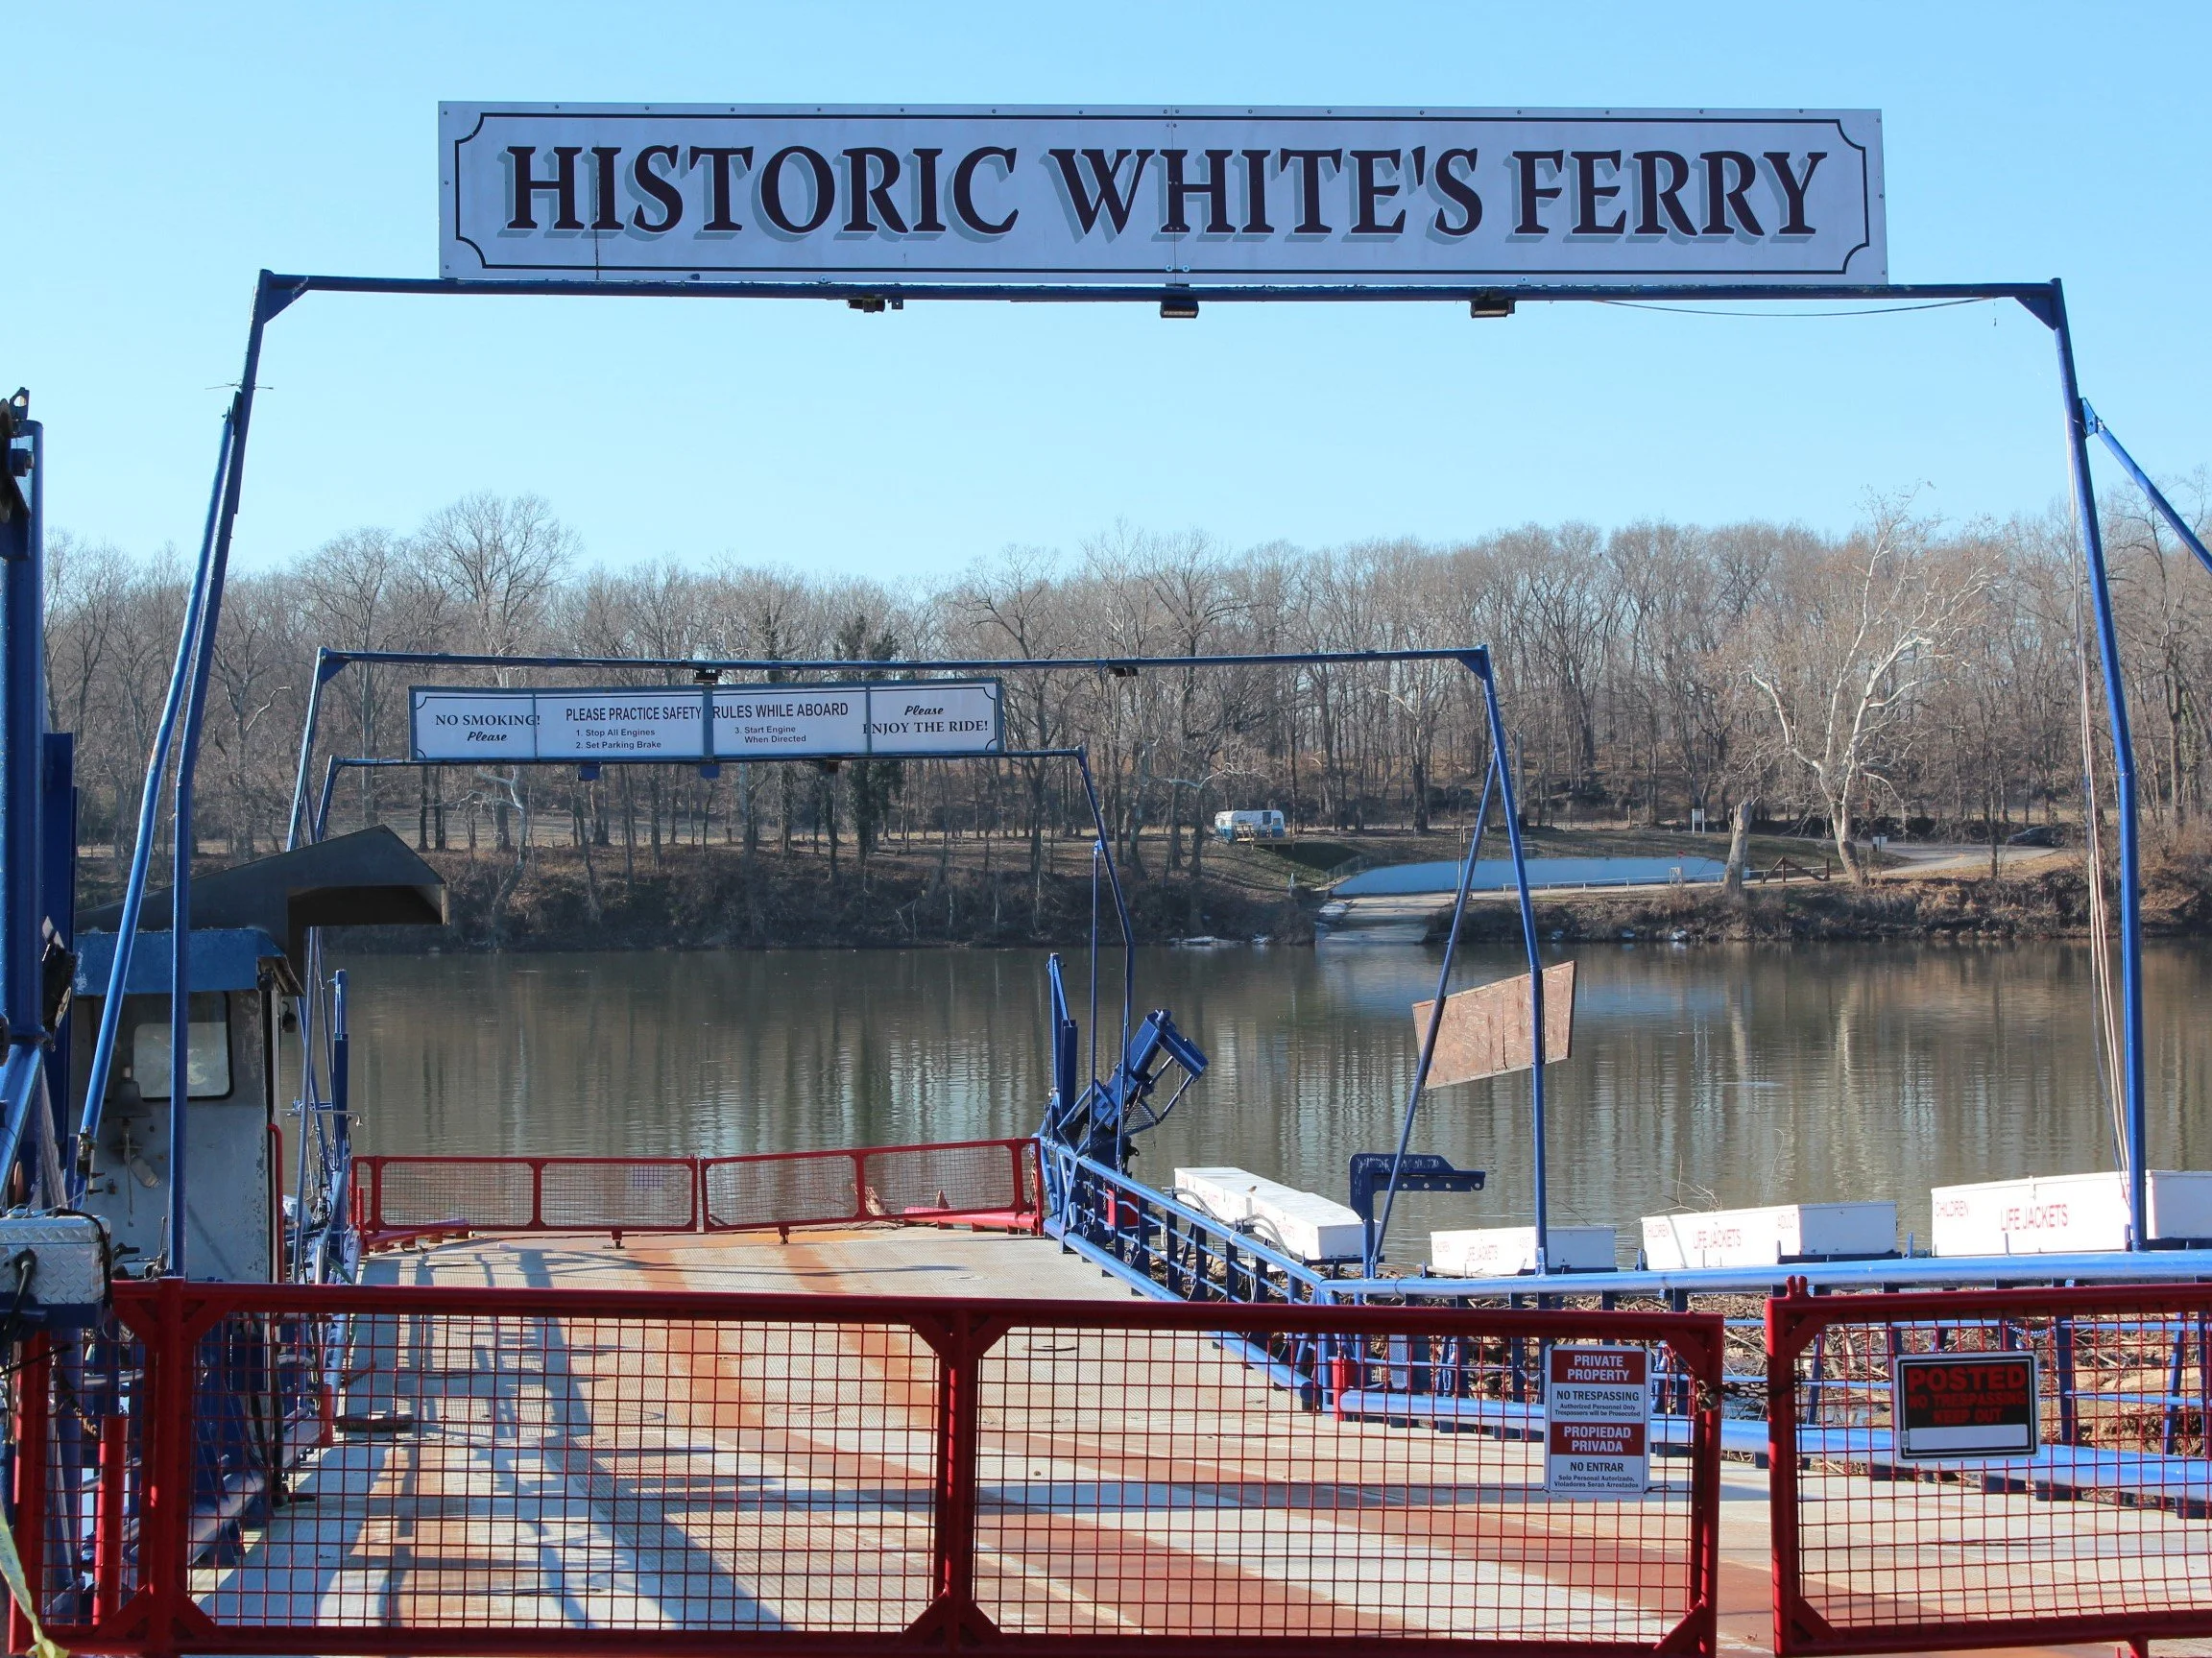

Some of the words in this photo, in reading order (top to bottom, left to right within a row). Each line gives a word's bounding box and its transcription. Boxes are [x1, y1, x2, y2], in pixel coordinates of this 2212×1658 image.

[506, 145, 1020, 233] HISTORIC
[1048, 146, 1483, 236] WHITE'S
[1511, 149, 1828, 237] FERRY
[565, 708, 607, 721] PLEASE
[609, 707, 660, 721] PRACTICE
[662, 706, 702, 720] SAFETY
[712, 705, 753, 719] RULES
[756, 704, 794, 718] WHILE
[797, 702, 849, 717] ABOARD
[904, 705, 944, 715] Please
[435, 714, 458, 726] NO
[463, 714, 541, 726] SMOKING!
[766, 726, 796, 735] Engine
[914, 721, 945, 733] THE
[949, 720, 988, 732] RIDE!
[467, 731, 508, 742] Please
[586, 729, 605, 737] Stop
[607, 728, 619, 736] All
[621, 728, 656, 738] Engines
[771, 734, 806, 743] Directed
[602, 740, 635, 751] Parking
[2000, 1207, 2020, 1231] LIFE
[2023, 1204, 2068, 1229] JACKETS
[1574, 1355, 1623, 1367] PRIVATE
[1567, 1368, 1630, 1382] PROPERTY
[1907, 1366, 2027, 1391] POSTED
[1556, 1390, 1570, 1401] NO
[1574, 1390, 1639, 1402] TRESPASSING
[1908, 1394, 1928, 1409] NO
[1933, 1391, 2028, 1407] TRESPASSING
[1933, 1409, 1970, 1424] KEEP
[1975, 1407, 2003, 1423] OUT
[1564, 1426, 1631, 1438] PROPIEDAD
[1572, 1440, 1623, 1453] PRIVADA
[1570, 1461, 1584, 1472] NO
[1586, 1461, 1624, 1473] ENTRAR
